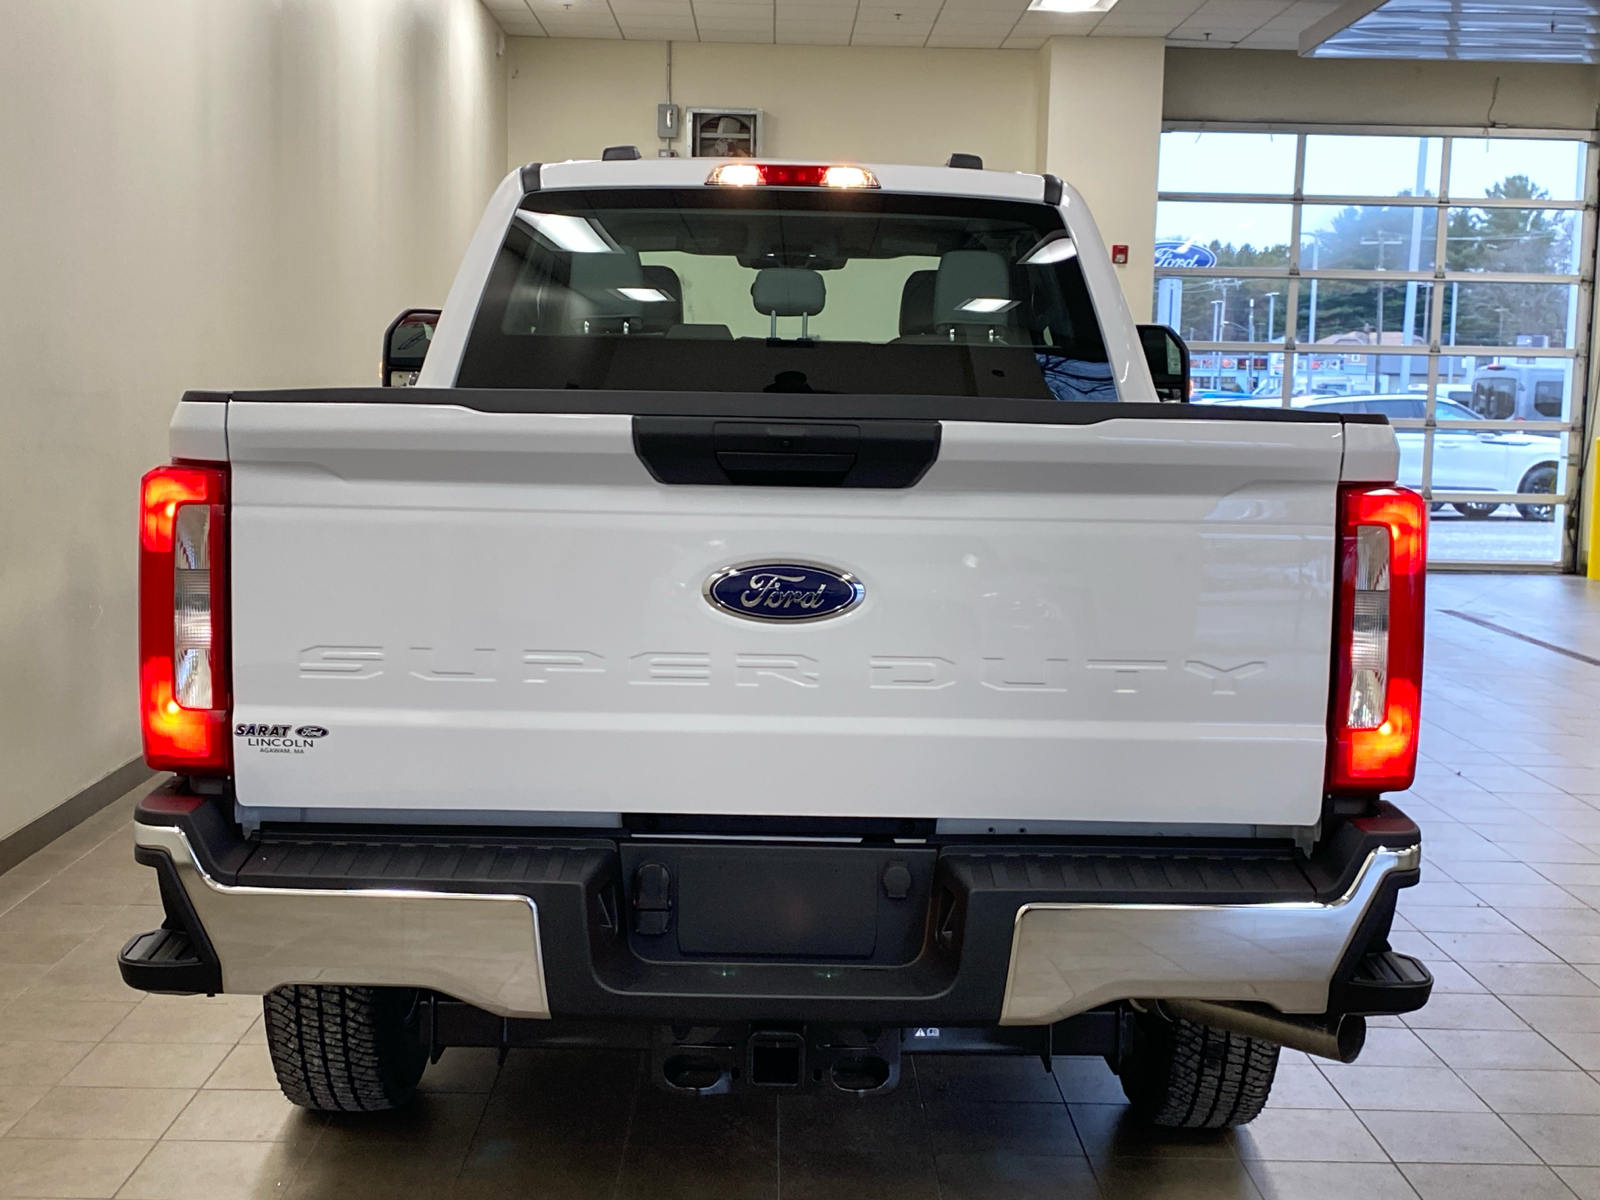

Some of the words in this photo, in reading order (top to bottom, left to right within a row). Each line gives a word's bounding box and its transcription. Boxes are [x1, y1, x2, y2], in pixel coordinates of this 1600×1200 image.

[1154, 247, 1199, 268] Ford
[740, 573, 827, 609] Ford
[299, 645, 820, 688] SUPER
[868, 655, 1268, 696] DUTY
[234, 723, 292, 738] SARAT
[248, 738, 314, 748] LINCOLN
